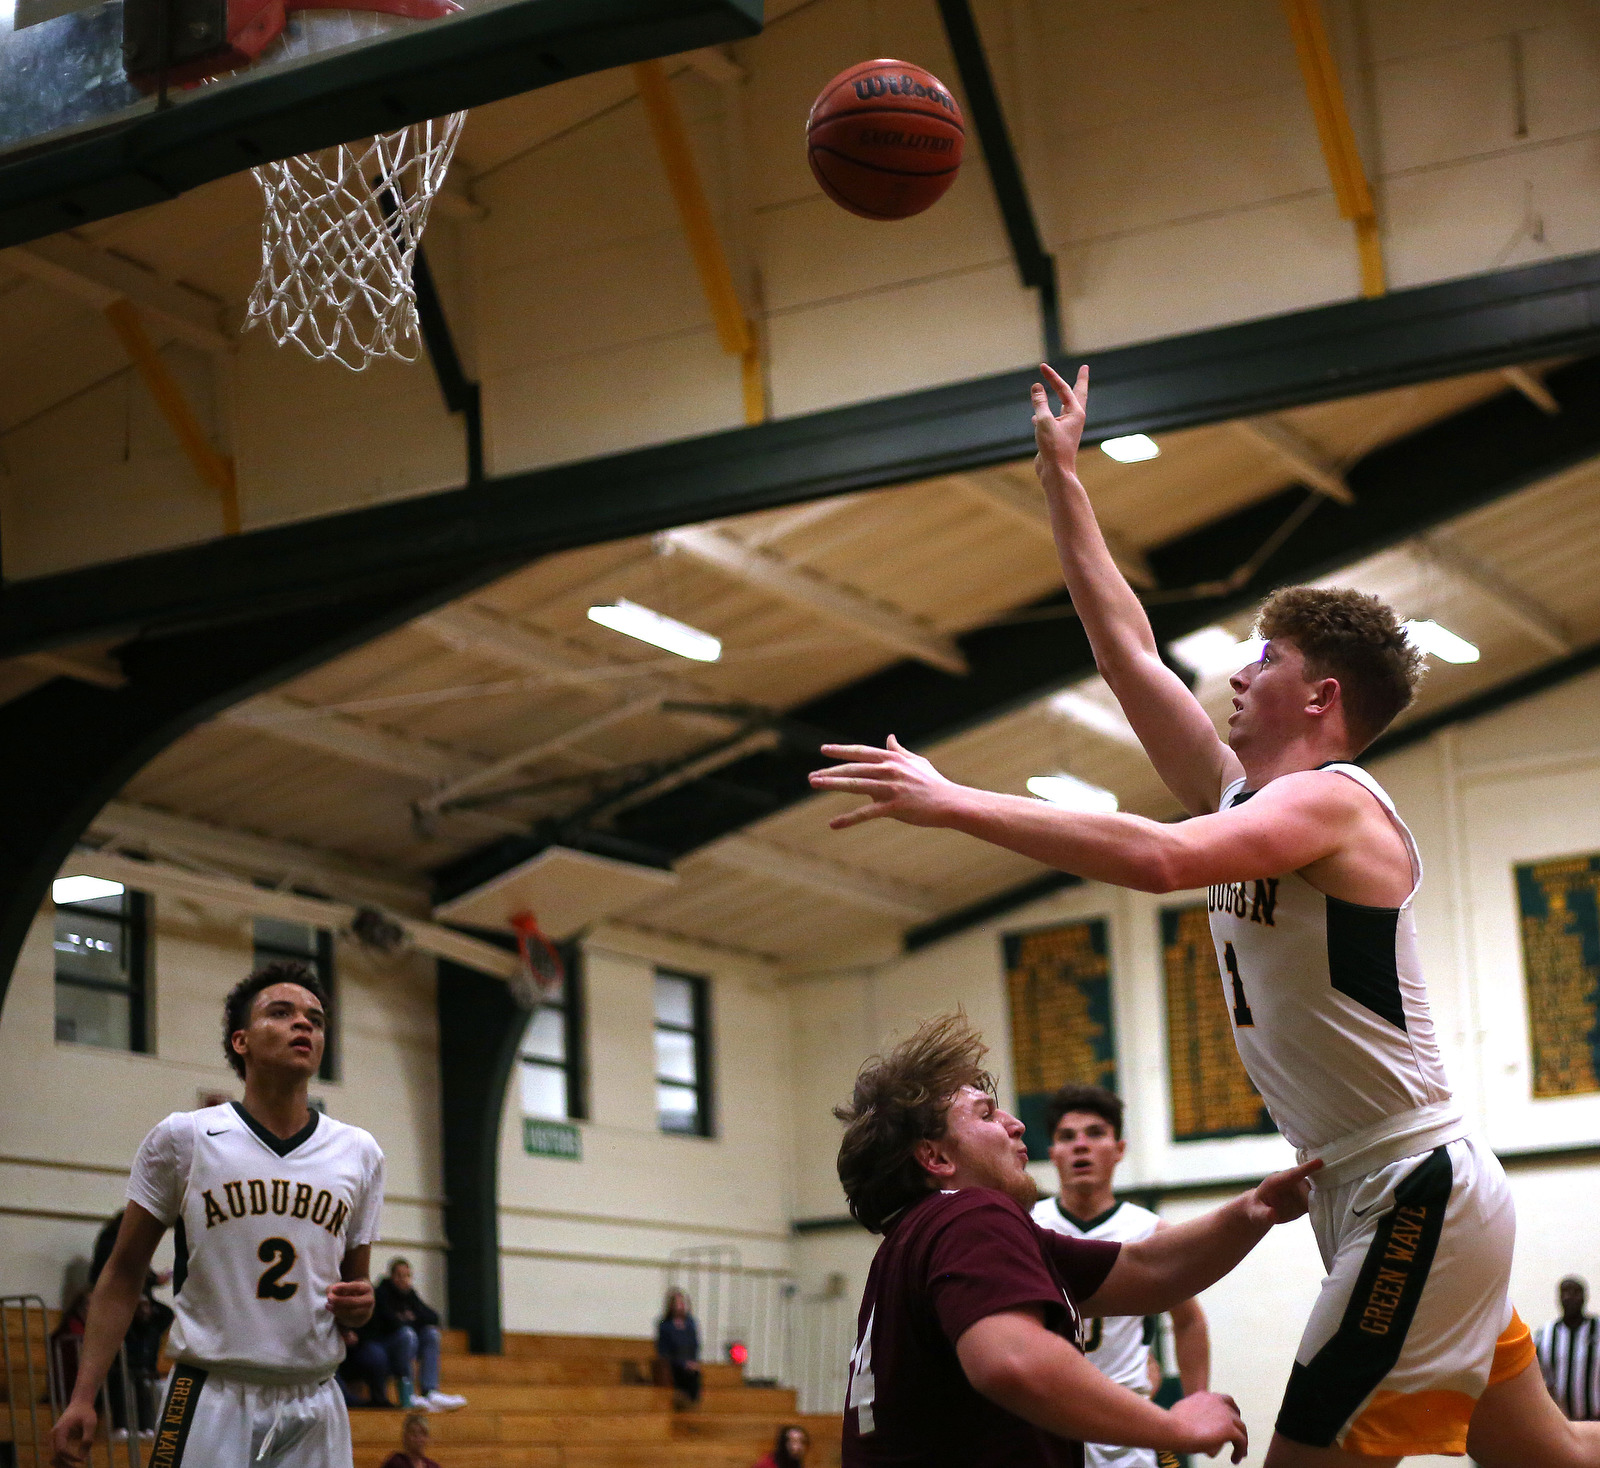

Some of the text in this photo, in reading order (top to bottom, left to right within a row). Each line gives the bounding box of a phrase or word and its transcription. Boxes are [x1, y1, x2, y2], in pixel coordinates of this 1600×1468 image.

[852, 74, 955, 113] Wilson
[1223, 940, 1256, 1028] 1
[201, 1178, 349, 1238] AUDUBON
[256, 1236, 299, 1301] 2
[1359, 1205, 1427, 1336] GREEN WAVE
[165, 1377, 193, 1425] GREEN
